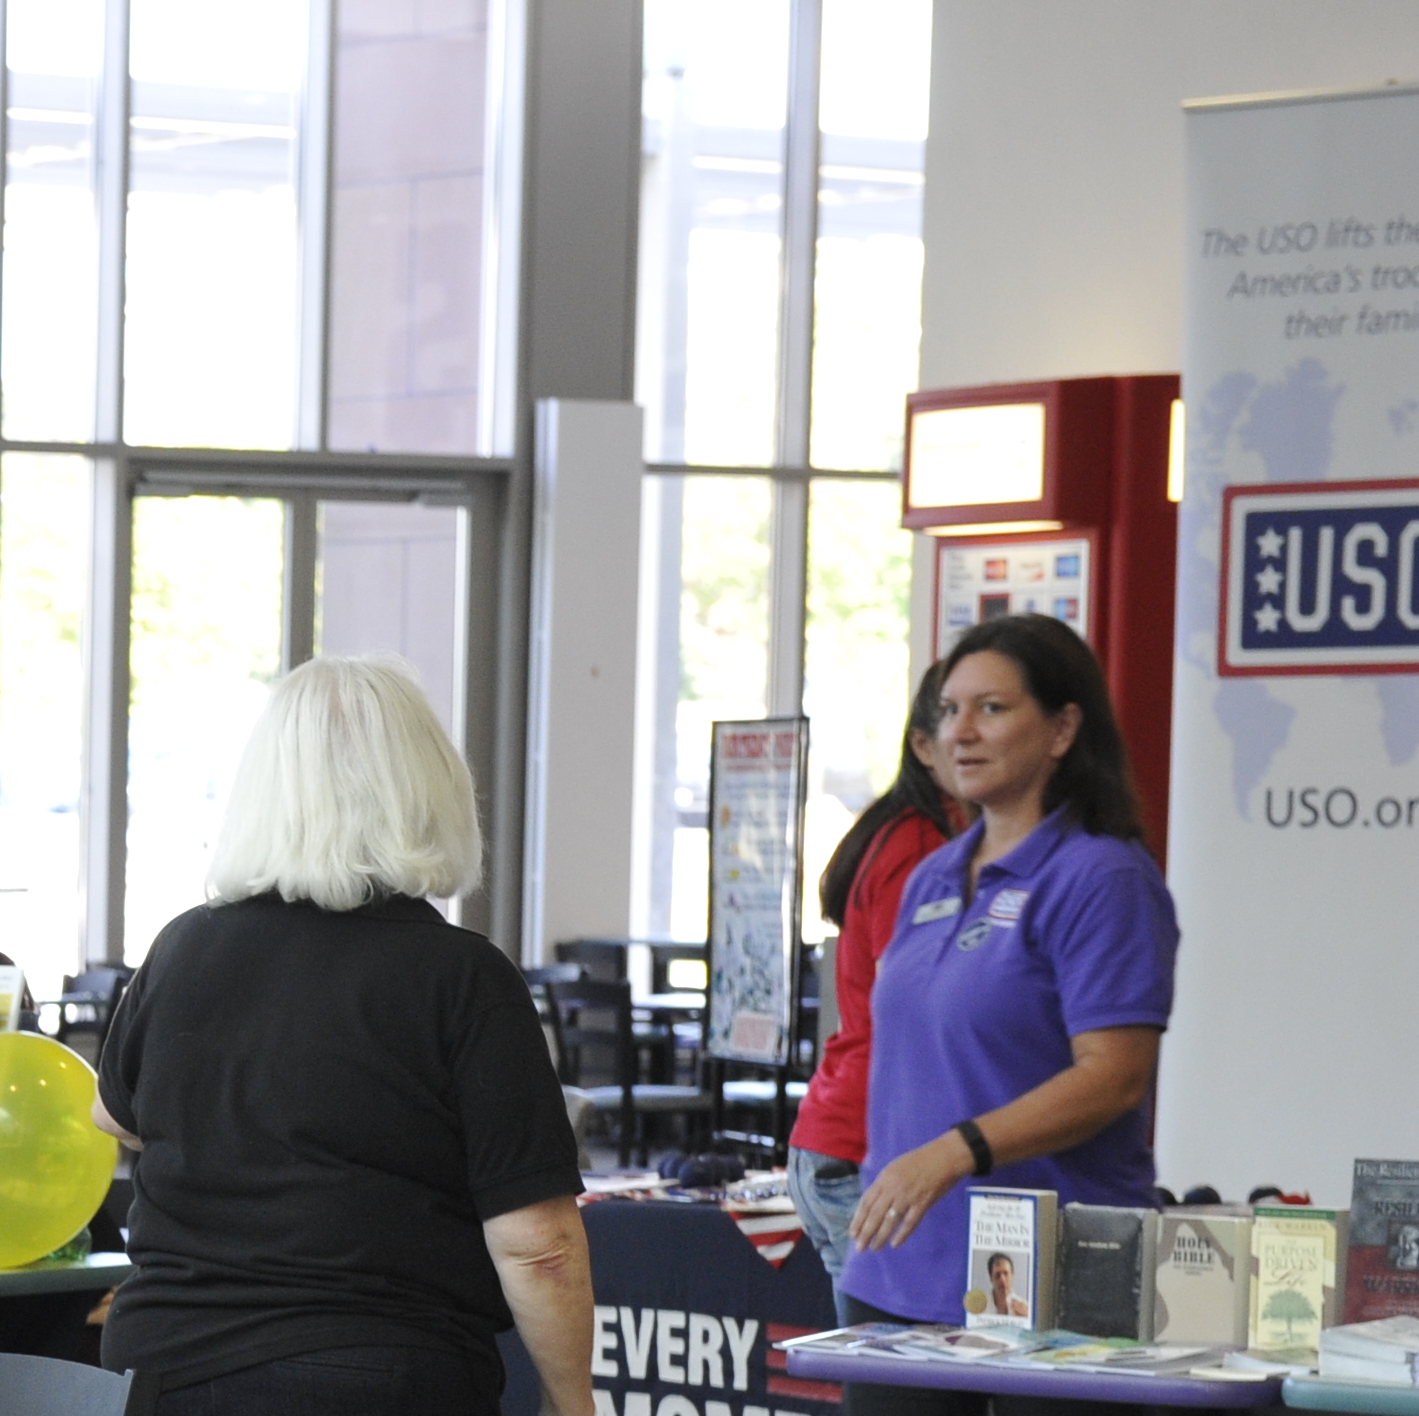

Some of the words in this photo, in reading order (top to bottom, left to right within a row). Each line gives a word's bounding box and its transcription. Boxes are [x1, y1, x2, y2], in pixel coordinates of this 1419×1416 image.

[1201, 227, 1249, 258] The
[1256, 221, 1318, 254] USO
[1324, 216, 1377, 249] lifts
[1226, 264, 1362, 299] America's
[1283, 309, 1349, 340] their
[1173, 1251, 1214, 1263] BIBLE
[1177, 1236, 1210, 1248] HOLY
[591, 1305, 759, 1391] EVERY
